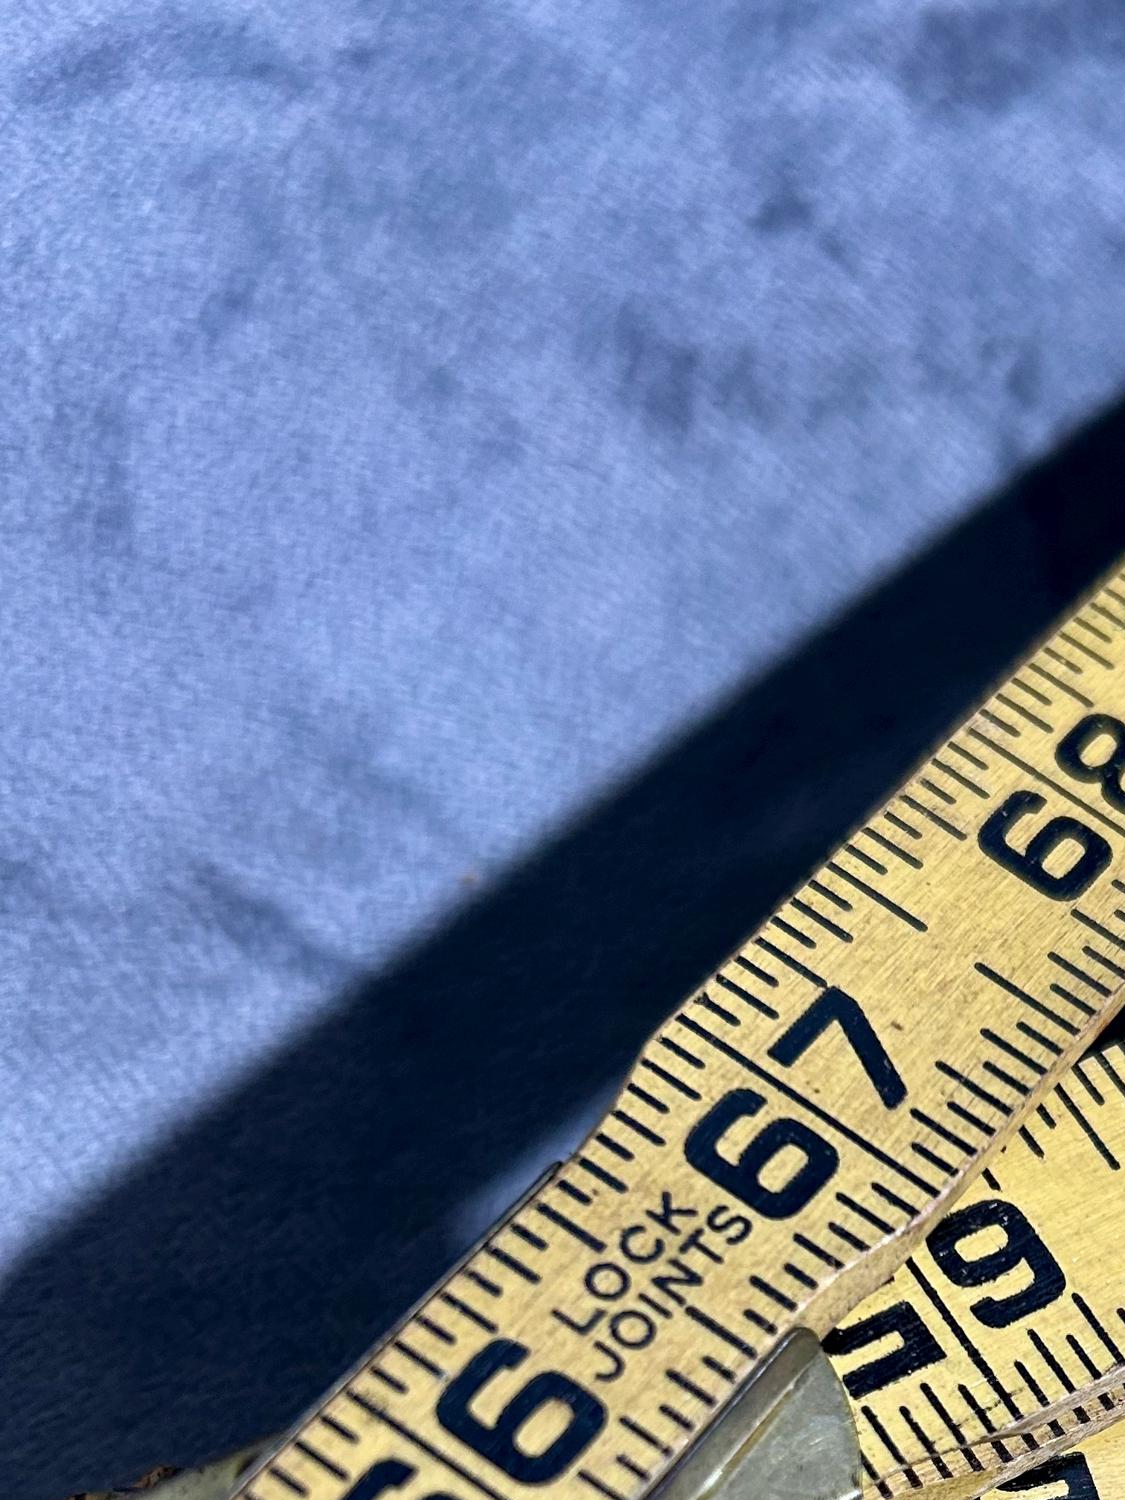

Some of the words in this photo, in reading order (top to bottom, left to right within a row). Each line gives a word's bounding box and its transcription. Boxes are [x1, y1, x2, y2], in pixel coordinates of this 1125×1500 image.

[684, 986, 908, 1221] 67
[554, 1191, 698, 1334] LOCK
[594, 1204, 755, 1382] JOINTS
